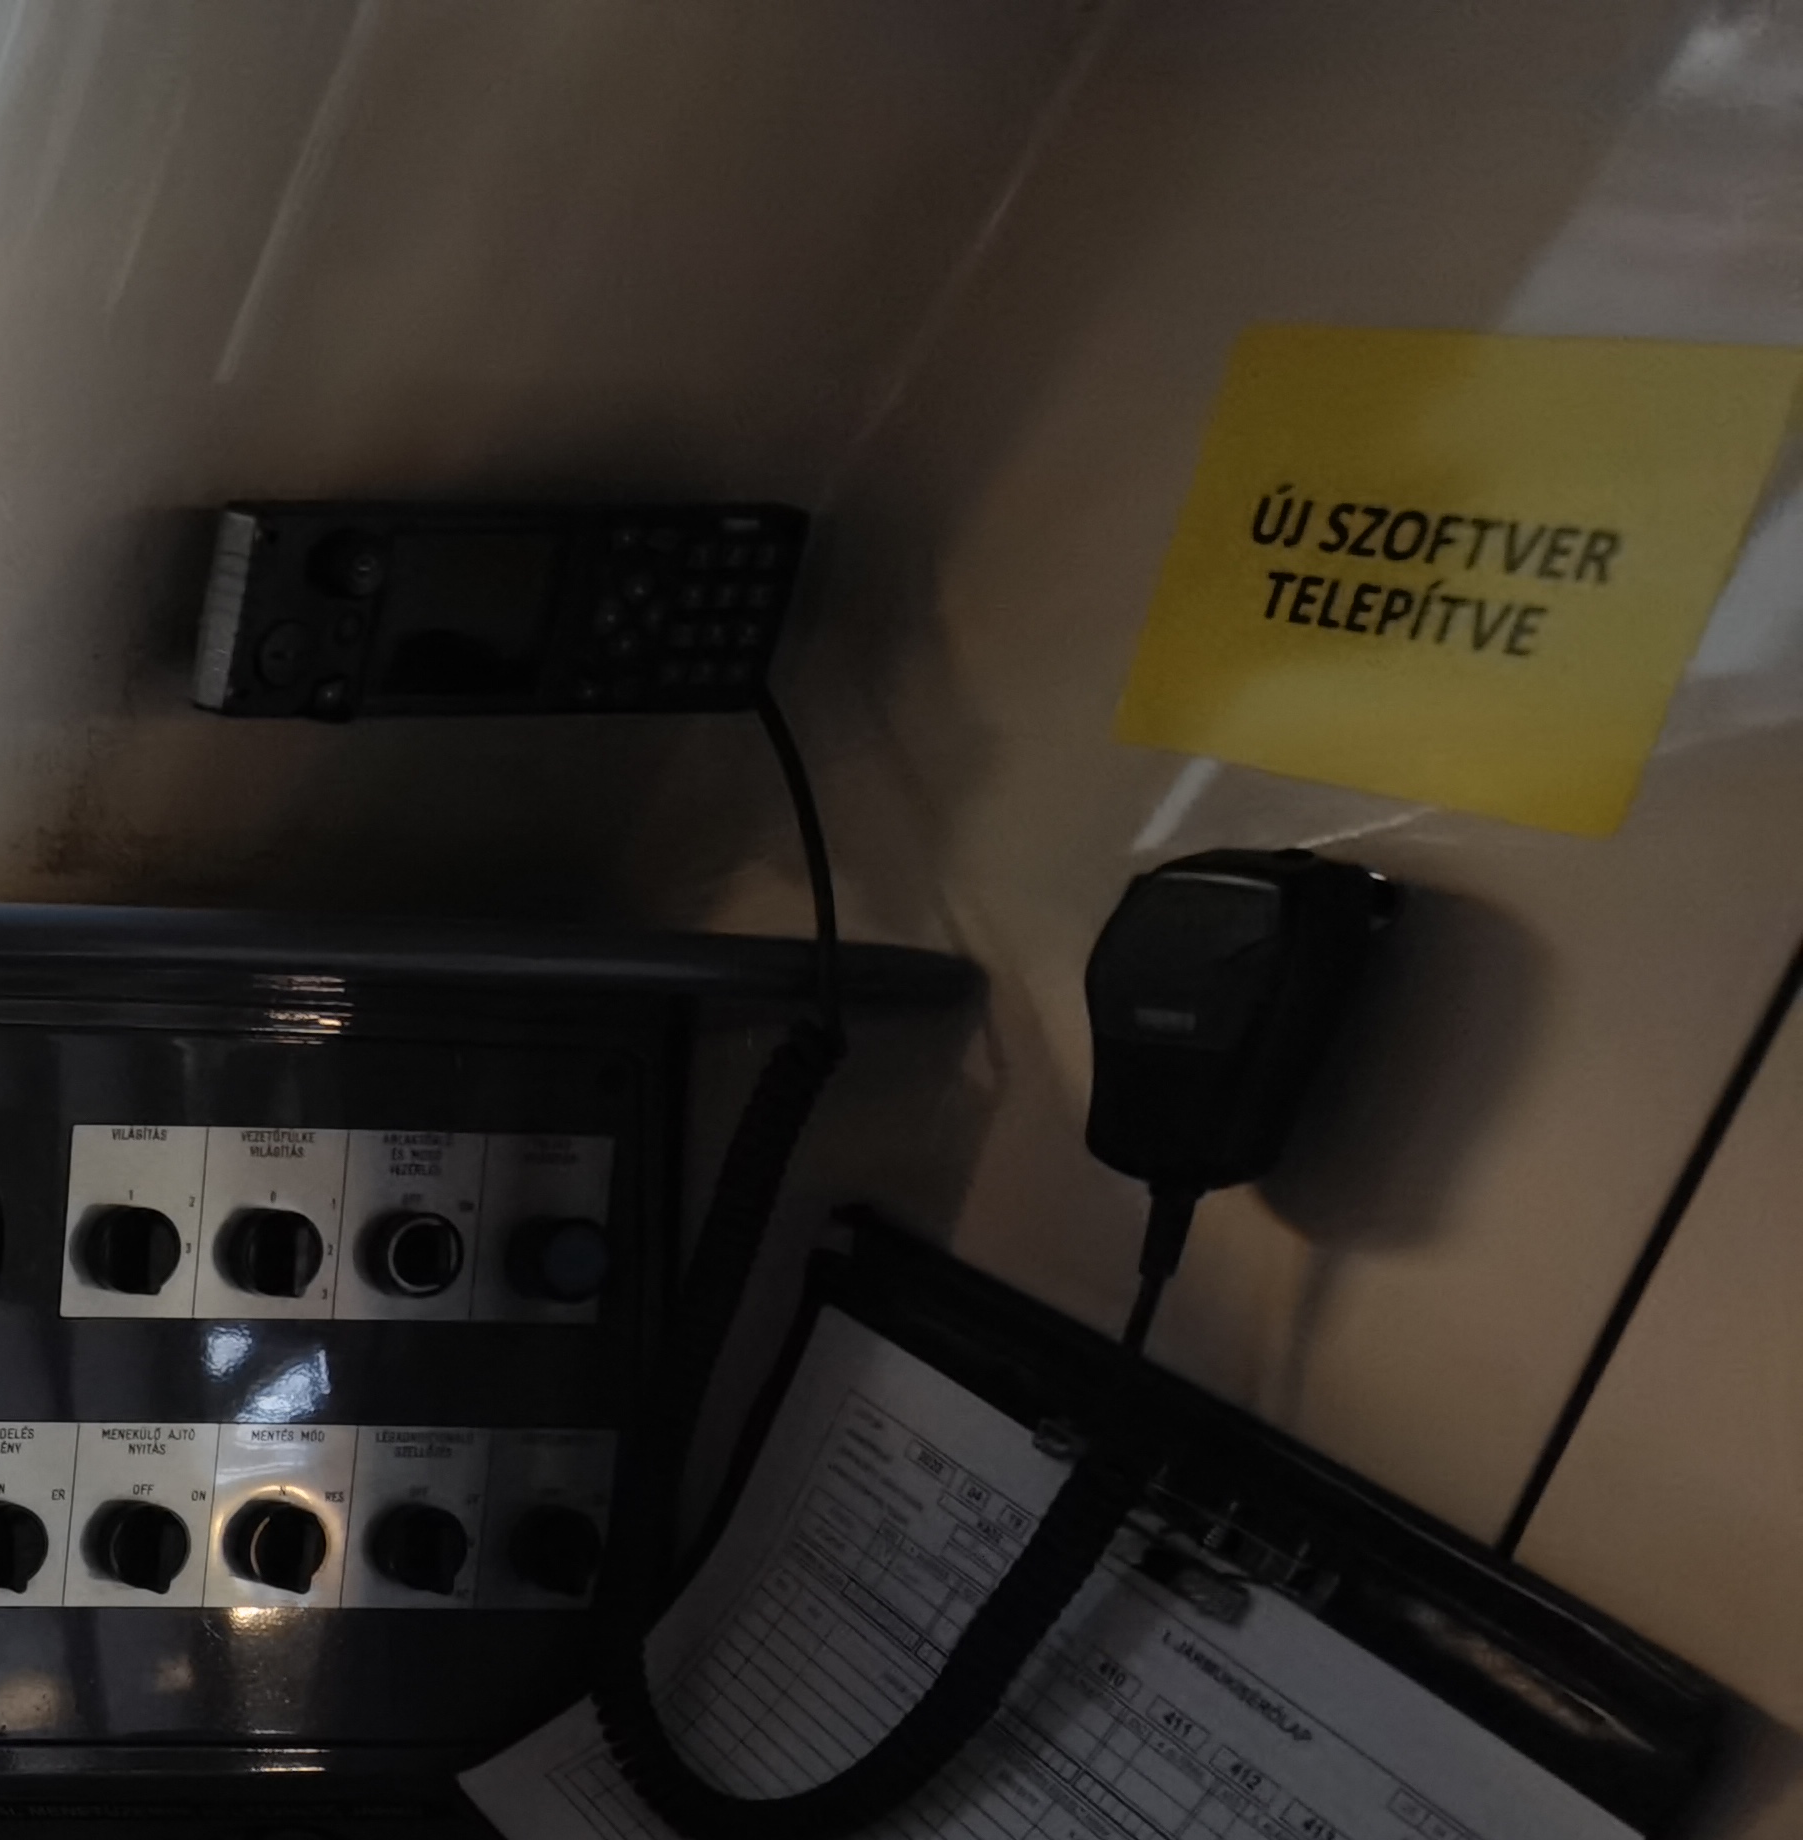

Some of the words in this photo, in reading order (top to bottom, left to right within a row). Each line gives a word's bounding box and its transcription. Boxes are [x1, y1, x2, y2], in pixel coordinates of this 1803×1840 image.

[1251, 484, 1313, 547] ÚJ
[1319, 501, 1622, 584] SZOFTVER
[1264, 570, 1548, 657] TELEPÍTVE
[111, 1127, 168, 1142] VILÁGÍTÁS
[250, 1144, 305, 1158] VILÁGÍTÁS
[101, 1427, 161, 1441] MENEKÜLŐ
[168, 1428, 196, 1441] AJTÓ
[251, 1428, 295, 1442] MENTÉS
[301, 1429, 325, 1443] MÓD
[128, 1441, 167, 1455] NYITÁS
[51, 1489, 66, 1501] ER
[132, 1484, 155, 1496] OFF
[191, 1490, 207, 1502] ON
[324, 1491, 344, 1503] RES
[1229, 1761, 1263, 1792] 412
